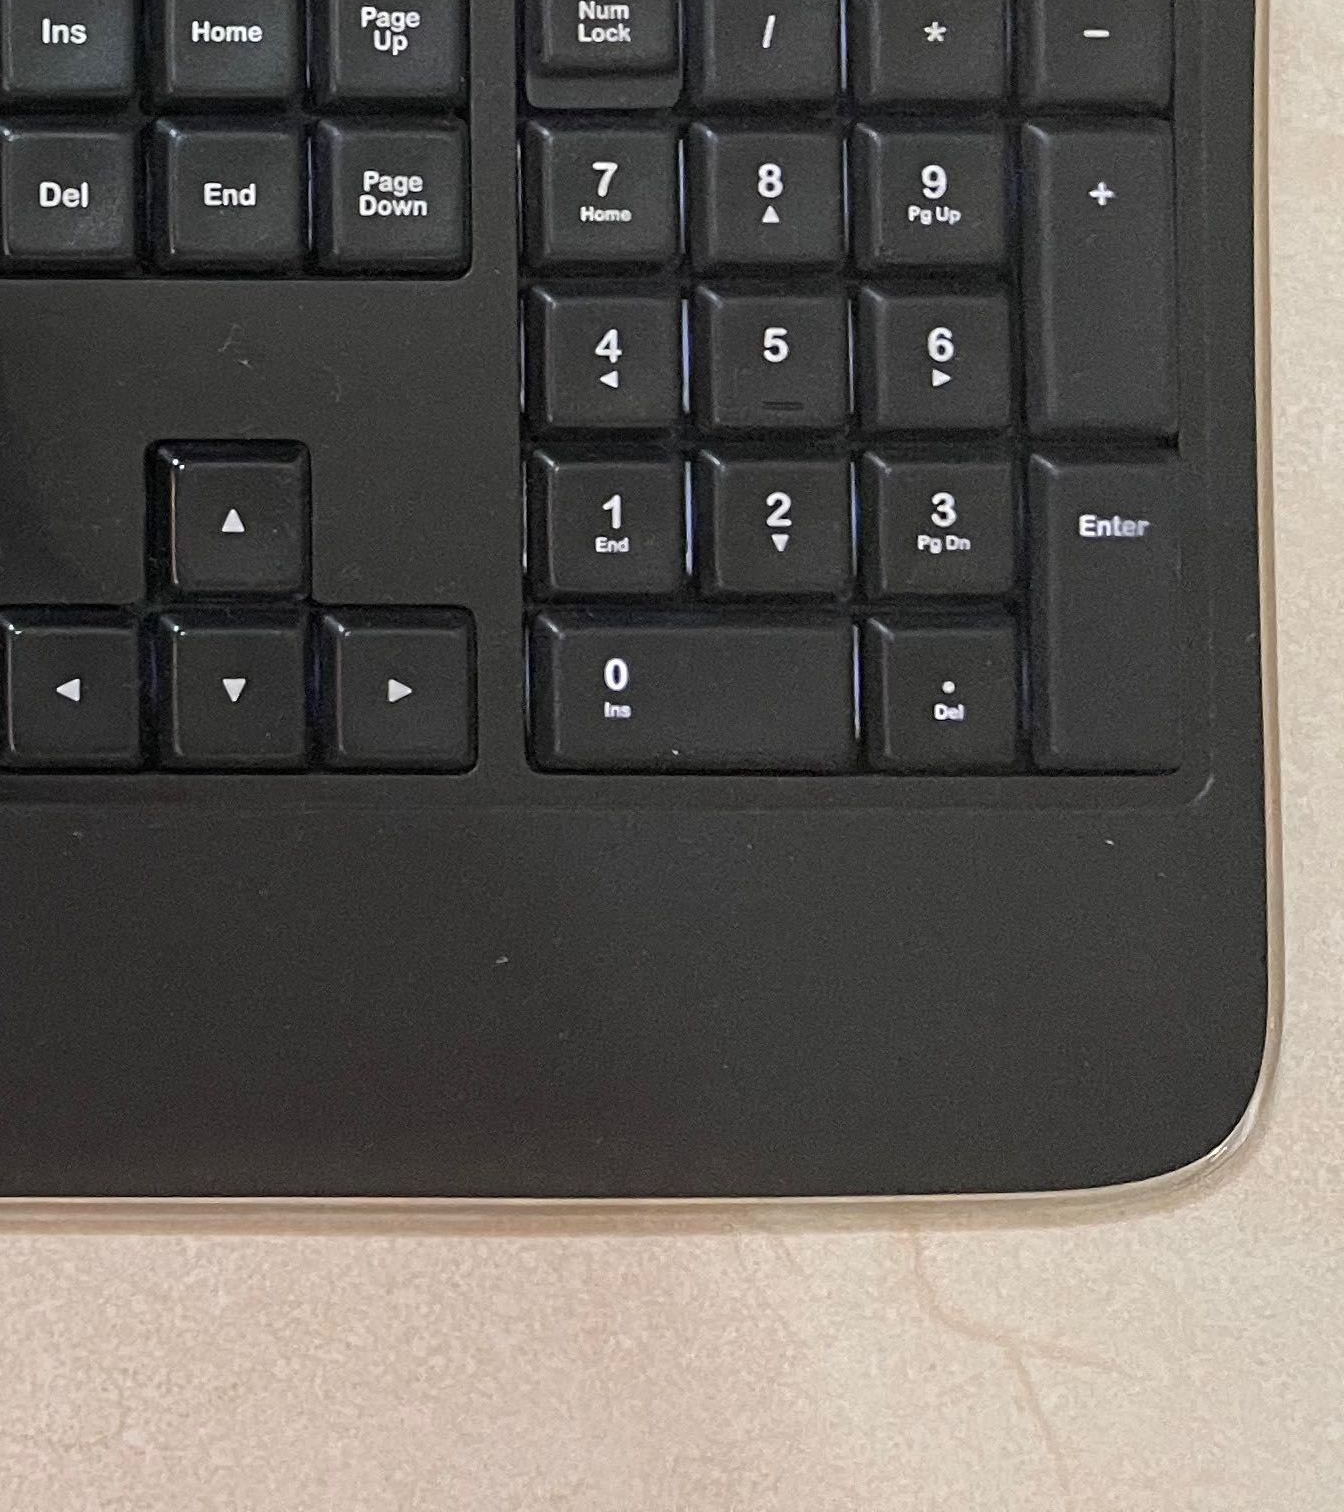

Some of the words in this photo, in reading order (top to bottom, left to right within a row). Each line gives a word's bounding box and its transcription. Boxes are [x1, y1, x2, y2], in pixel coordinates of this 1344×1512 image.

[360, 6, 421, 33] Page
[578, 0, 630, 20] Num
[42, 18, 88, 45] Ins
[191, 20, 263, 43] Home
[373, 29, 409, 56] Up
[577, 22, 632, 43] Lock
[762, 14, 776, 49] /
[362, 170, 425, 197] Page
[592, 161, 618, 198] 7
[757, 163, 784, 198] 8
[921, 164, 948, 199] 9
[39, 181, 89, 208] Del
[203, 182, 256, 206] End
[359, 195, 428, 216] Down
[1089, 181, 1114, 206] +
[580, 206, 632, 222] Home
[908, 205, 933, 226] Pg
[935, 206, 962, 225] Up
[594, 328, 623, 364] 4
[763, 327, 789, 363] 5
[927, 327, 955, 362] 6
[602, 494, 622, 530] 1
[766, 491, 792, 527] 2
[931, 492, 957, 528] 3
[1079, 514, 1150, 538] Enter
[595, 536, 630, 553] End
[917, 534, 943, 554] Pg
[945, 534, 971, 551] Dn
[604, 657, 629, 692] 0
[604, 701, 632, 718] Ins
[933, 703, 965, 721] Del
